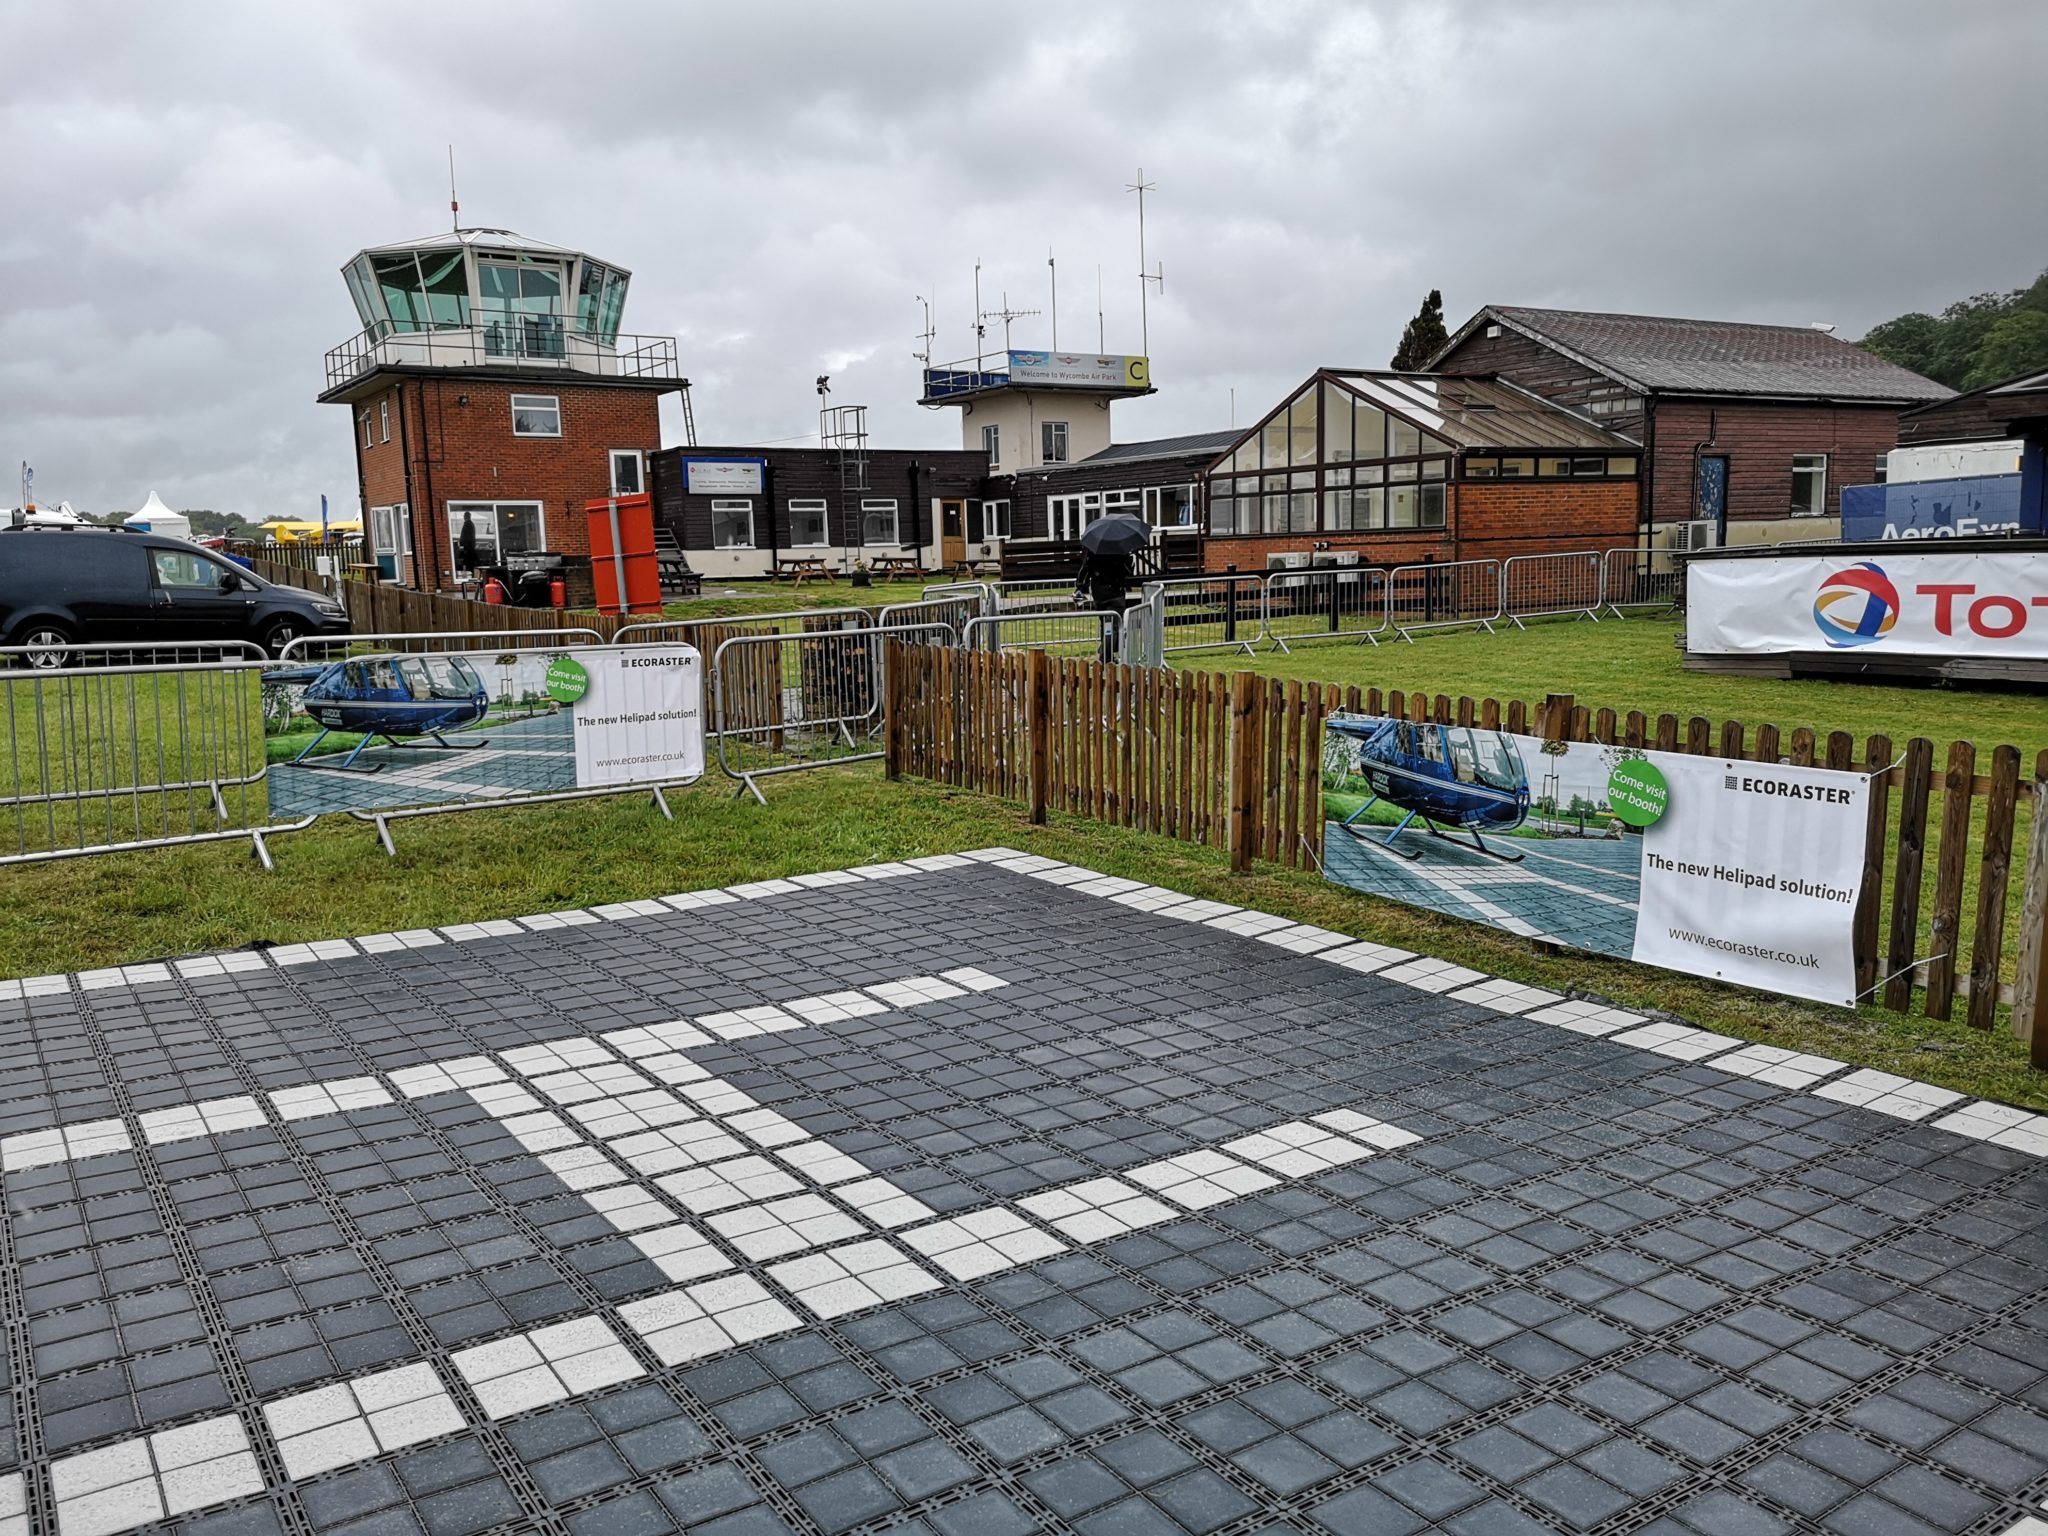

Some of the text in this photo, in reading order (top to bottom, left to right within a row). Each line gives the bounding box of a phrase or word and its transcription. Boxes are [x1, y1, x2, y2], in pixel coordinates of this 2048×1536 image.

[1020, 370, 1050, 378] Welcome
[1060, 371, 1090, 380] Wycombe
[1129, 361, 1144, 380] C
[631, 657, 692, 668] ECORASTER
[548, 667, 586, 683] Come visit
[546, 680, 585, 693] our booth!
[577, 709, 697, 727] The new Helipad solution!
[596, 750, 685, 767] www.ecoraster.co.uk
[1613, 770, 1667, 801] Come visit
[1742, 778, 1851, 805] ECORASTER
[1608, 788, 1663, 816] our booth!
[1647, 853, 1853, 904] The new Helipad solution!
[1669, 928, 1820, 969] www.ecoraster.co.uk
